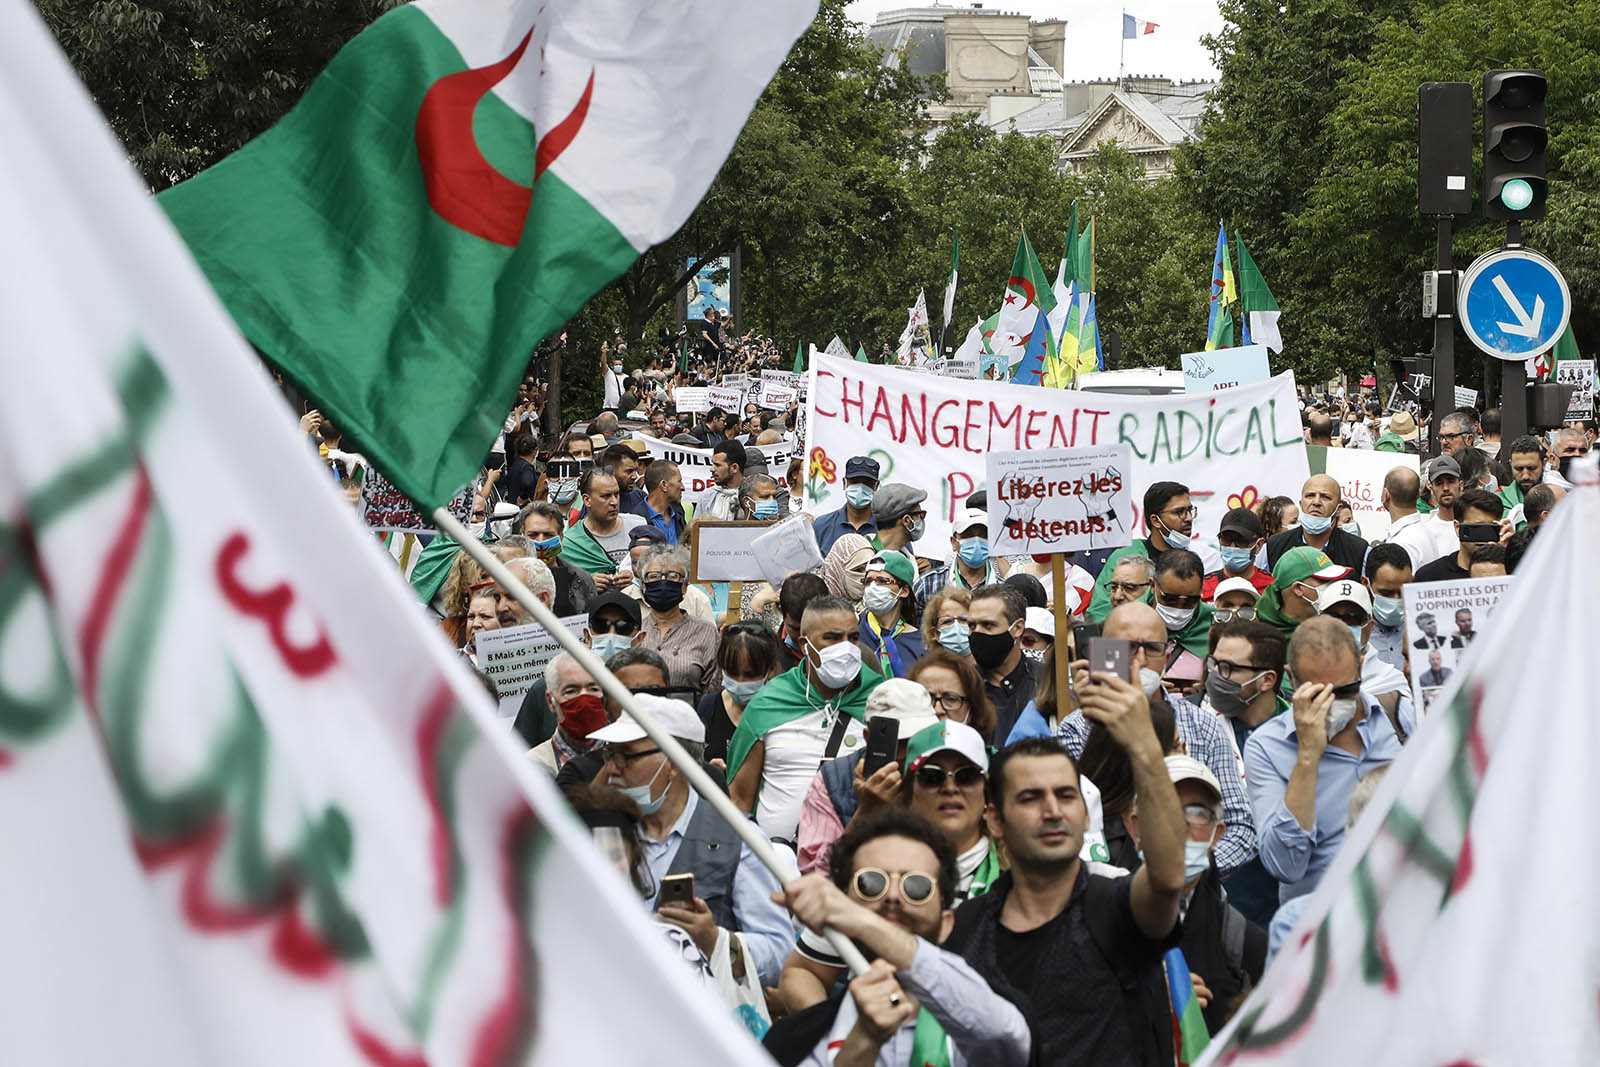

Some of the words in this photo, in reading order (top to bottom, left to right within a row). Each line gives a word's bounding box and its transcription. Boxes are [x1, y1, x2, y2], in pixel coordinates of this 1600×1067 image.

[815, 370, 1110, 453] CHANGEMENT
[997, 476, 1084, 501] Libérez
[1089, 472, 1123, 495] les
[1008, 517, 1113, 540] détenus.
[1340, 583, 1353, 596] B
[1417, 587, 1461, 600] LIBEREZ
[1463, 585, 1482, 596] LES
[1415, 598, 1473, 612] D'OPINION
[1475, 597, 1490, 607] EN
[487, 653, 494, 662] 8
[515, 648, 527, 657] 45
[485, 666, 506, 676] 2019
[511, 662, 522, 671] un
[523, 657, 549, 669] même
[497, 672, 546, 686] souverainet
[499, 687, 519, 699] pour
